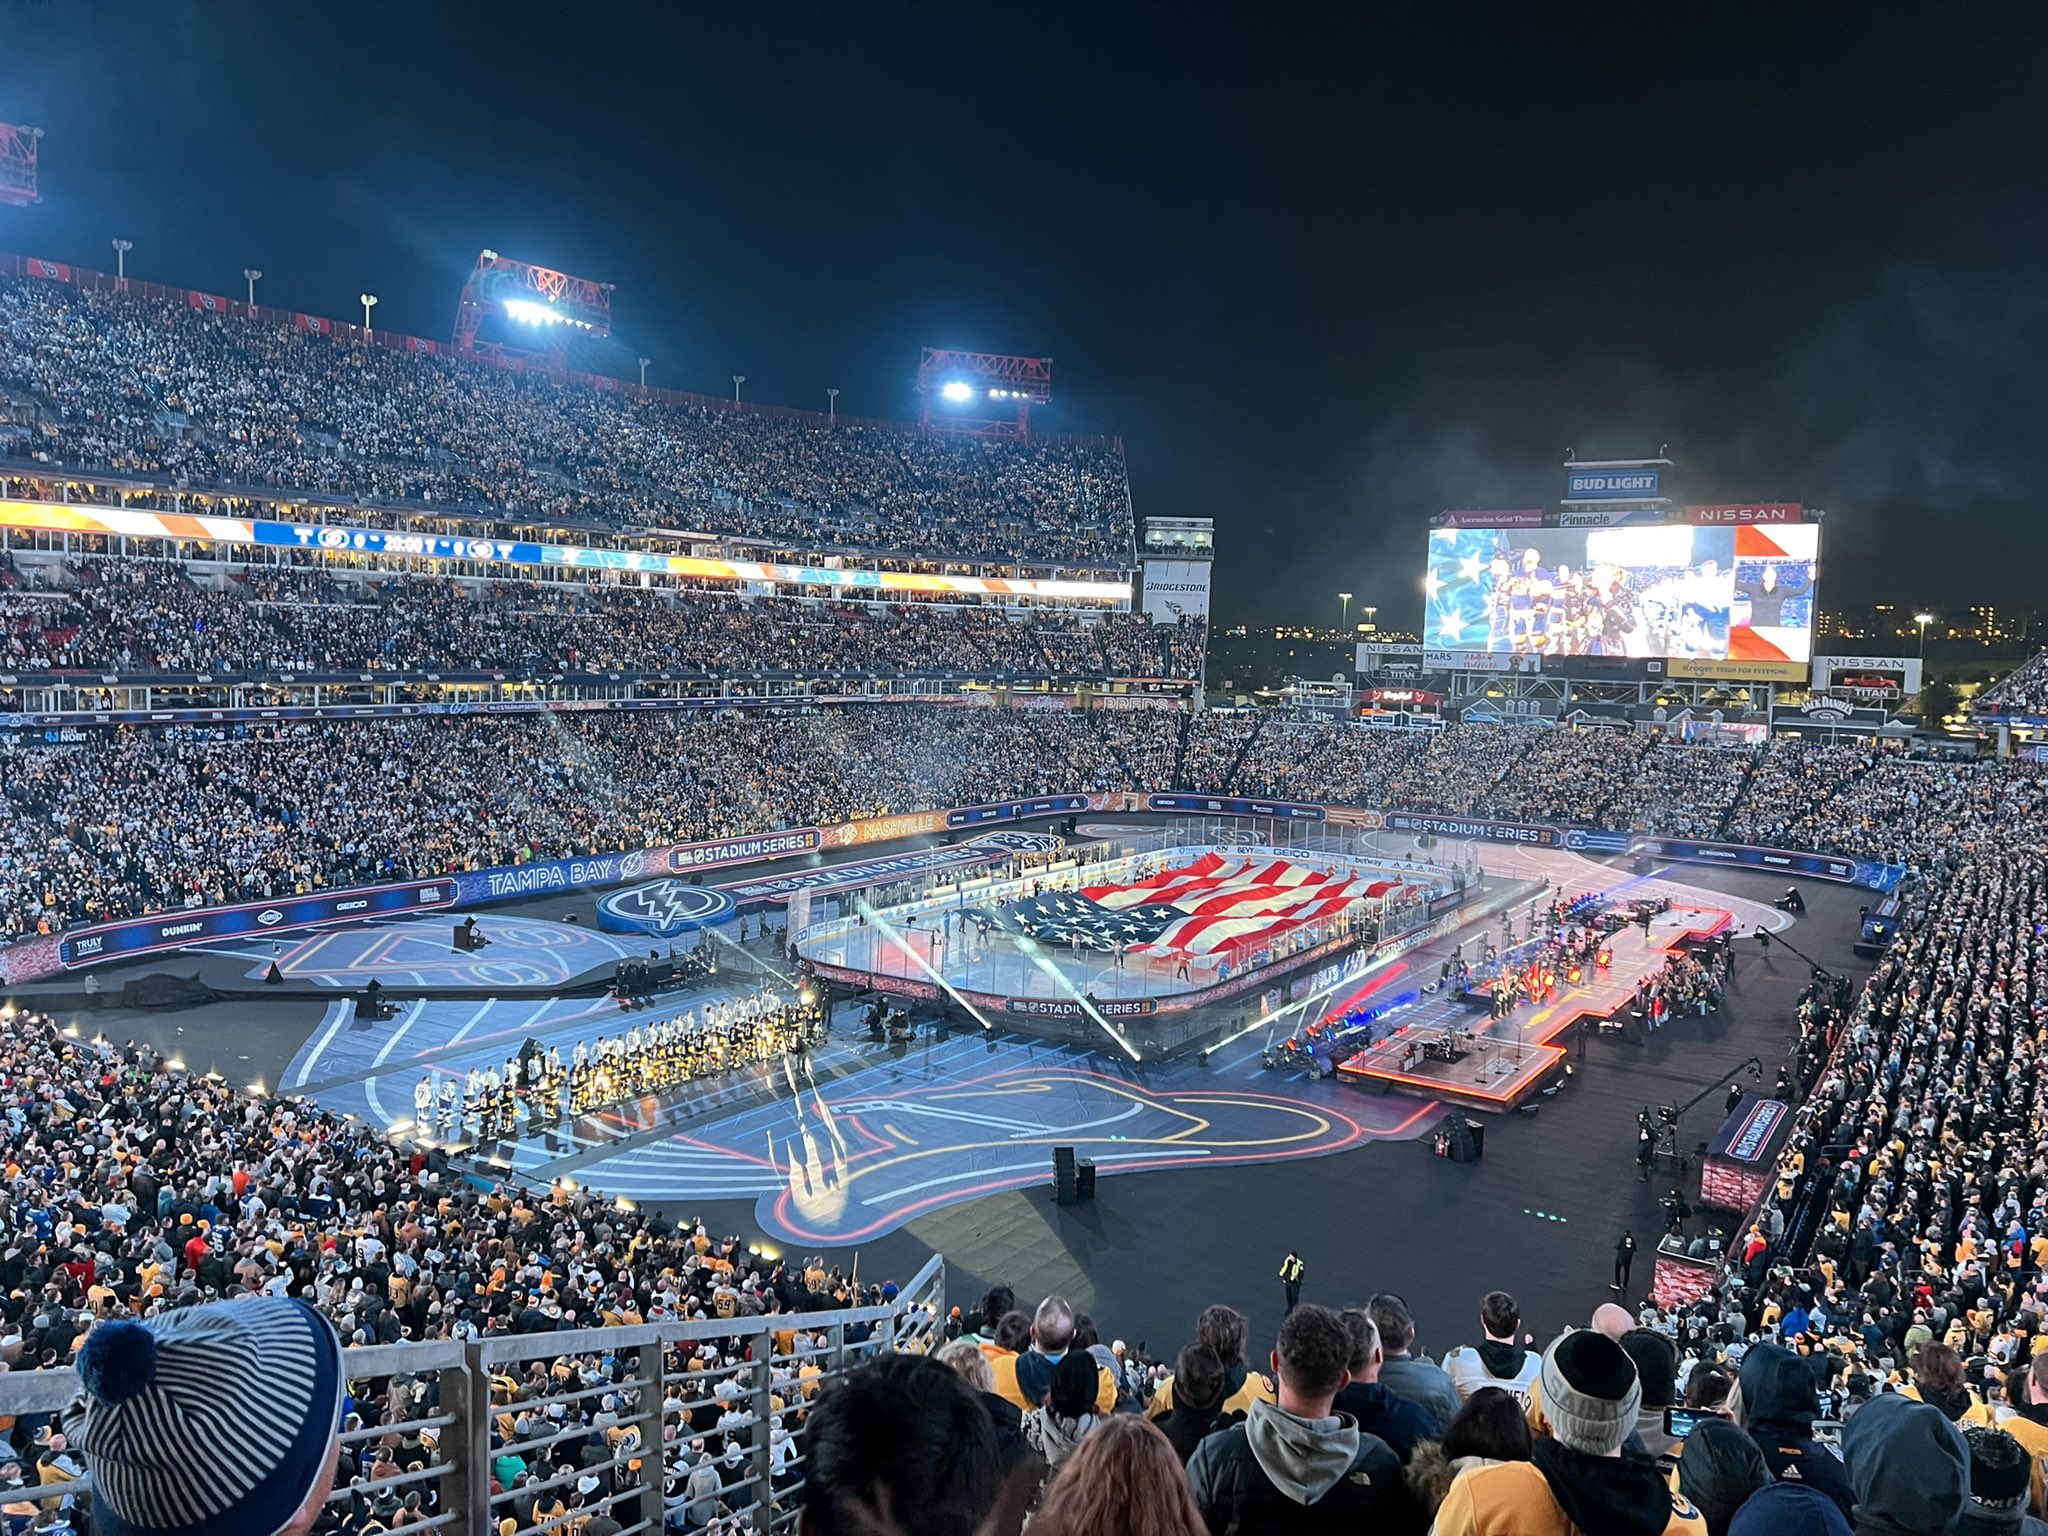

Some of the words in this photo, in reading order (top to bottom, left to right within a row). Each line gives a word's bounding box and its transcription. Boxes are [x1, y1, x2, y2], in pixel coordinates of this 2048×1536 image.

[1573, 478, 1605, 491] BUD
[1607, 475, 1655, 490] LIGHT
[1459, 516, 1494, 524] Ascension
[1514, 515, 1542, 523] Thomas
[1561, 513, 1610, 526] Pinnacle
[1700, 509, 1786, 521] NISSAN
[1145, 581, 1207, 592] BRIDGESTONE
[1366, 644, 1423, 653] NISSAN
[1426, 653, 1452, 661] MARS
[1827, 657, 1905, 668] NISSAN
[1391, 671, 1415, 679] TITAN
[1683, 660, 1713, 677] Kroger
[1855, 687, 1888, 697] TITAN
[1800, 698, 1822, 713] JACK
[1821, 695, 1855, 716] DANIEL'S
[863, 814, 935, 840] NASHVILLE
[1422, 819, 1485, 836] STADIUM
[1486, 825, 1539, 842] SERIES
[704, 842, 761, 862] STADIUM
[762, 835, 805, 853] SERIES
[1273, 848, 1310, 859] GEICO
[795, 859, 905, 888] STADIUM
[906, 848, 983, 868] SERIES
[1354, 856, 1383, 867] betway
[488, 865, 566, 896] TAMPA
[570, 858, 613, 884] BAY
[336, 900, 368, 911] GEICO
[162, 922, 203, 937] DUNKIN'
[76, 936, 102, 950] TRULY
[1097, 1002, 1141, 1015] SERIES
